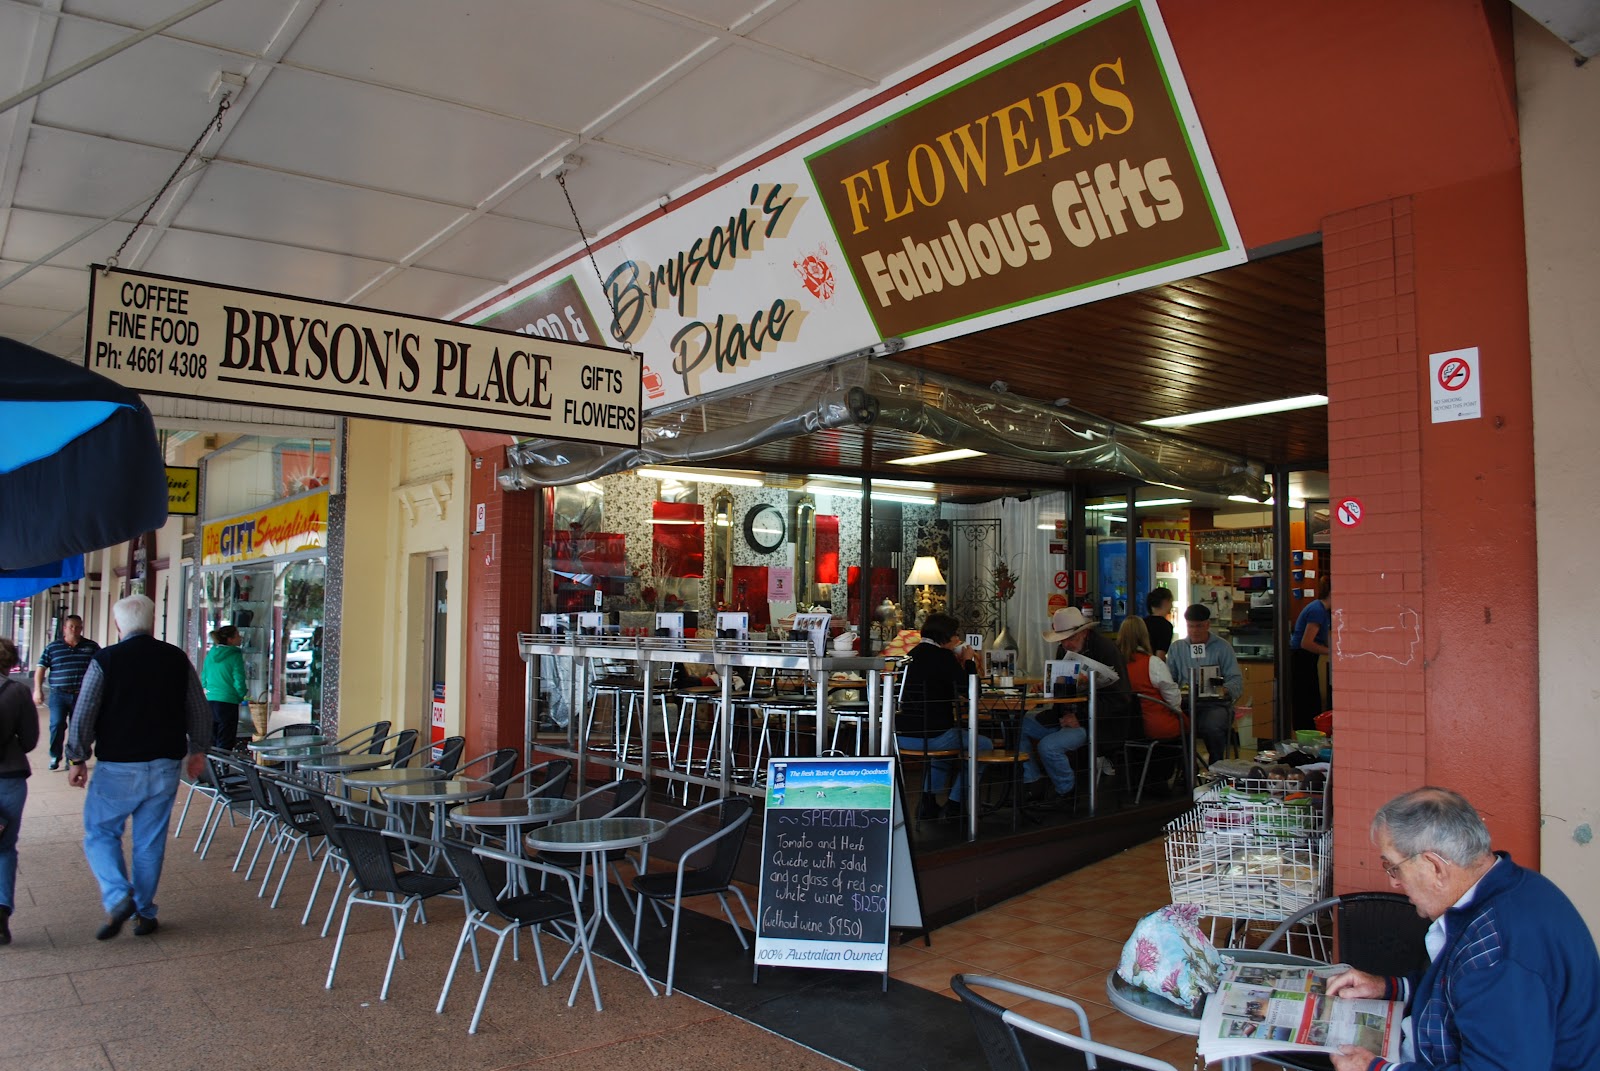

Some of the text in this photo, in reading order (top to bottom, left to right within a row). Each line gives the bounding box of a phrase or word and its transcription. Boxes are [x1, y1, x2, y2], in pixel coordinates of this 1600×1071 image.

[840, 57, 1135, 235] FLOWERS
[861, 157, 1184, 308] Fabulous Gifts
[603, 182, 794, 343] Bryson's
[121, 281, 189, 315] COFFEE
[108, 310, 199, 347] FINE FOOD
[564, 304, 590, 343] &
[95, 341, 207, 380] Ph: 4661 4308
[219, 305, 553, 410] BRYSON'S PLACE
[670, 297, 795, 396] Place
[581, 365, 623, 394] GIFTS
[564, 398, 636, 432] FLOWERS
[167, 476, 189, 489] ini
[168, 490, 190, 503] art
[219, 519, 257, 557] GIFT
[254, 509, 321, 548] Specialists
[969, 635, 979, 647] 10
[1192, 644, 1203, 655] 36
[837, 769, 860, 777] Country
[860, 768, 889, 777] Goodness
[801, 809, 870, 828] SPECIALS
[777, 832, 864, 851] Tomato and Herb
[772, 850, 867, 873] Quiche with salad
[769, 869, 884, 893] and a glass of red or
[776, 884, 806, 902] white
[814, 891, 843, 907] wine
[762, 905, 799, 932] (without
[800, 914, 823, 933] wine
[758, 948, 884, 961] 100% Australian Owned
